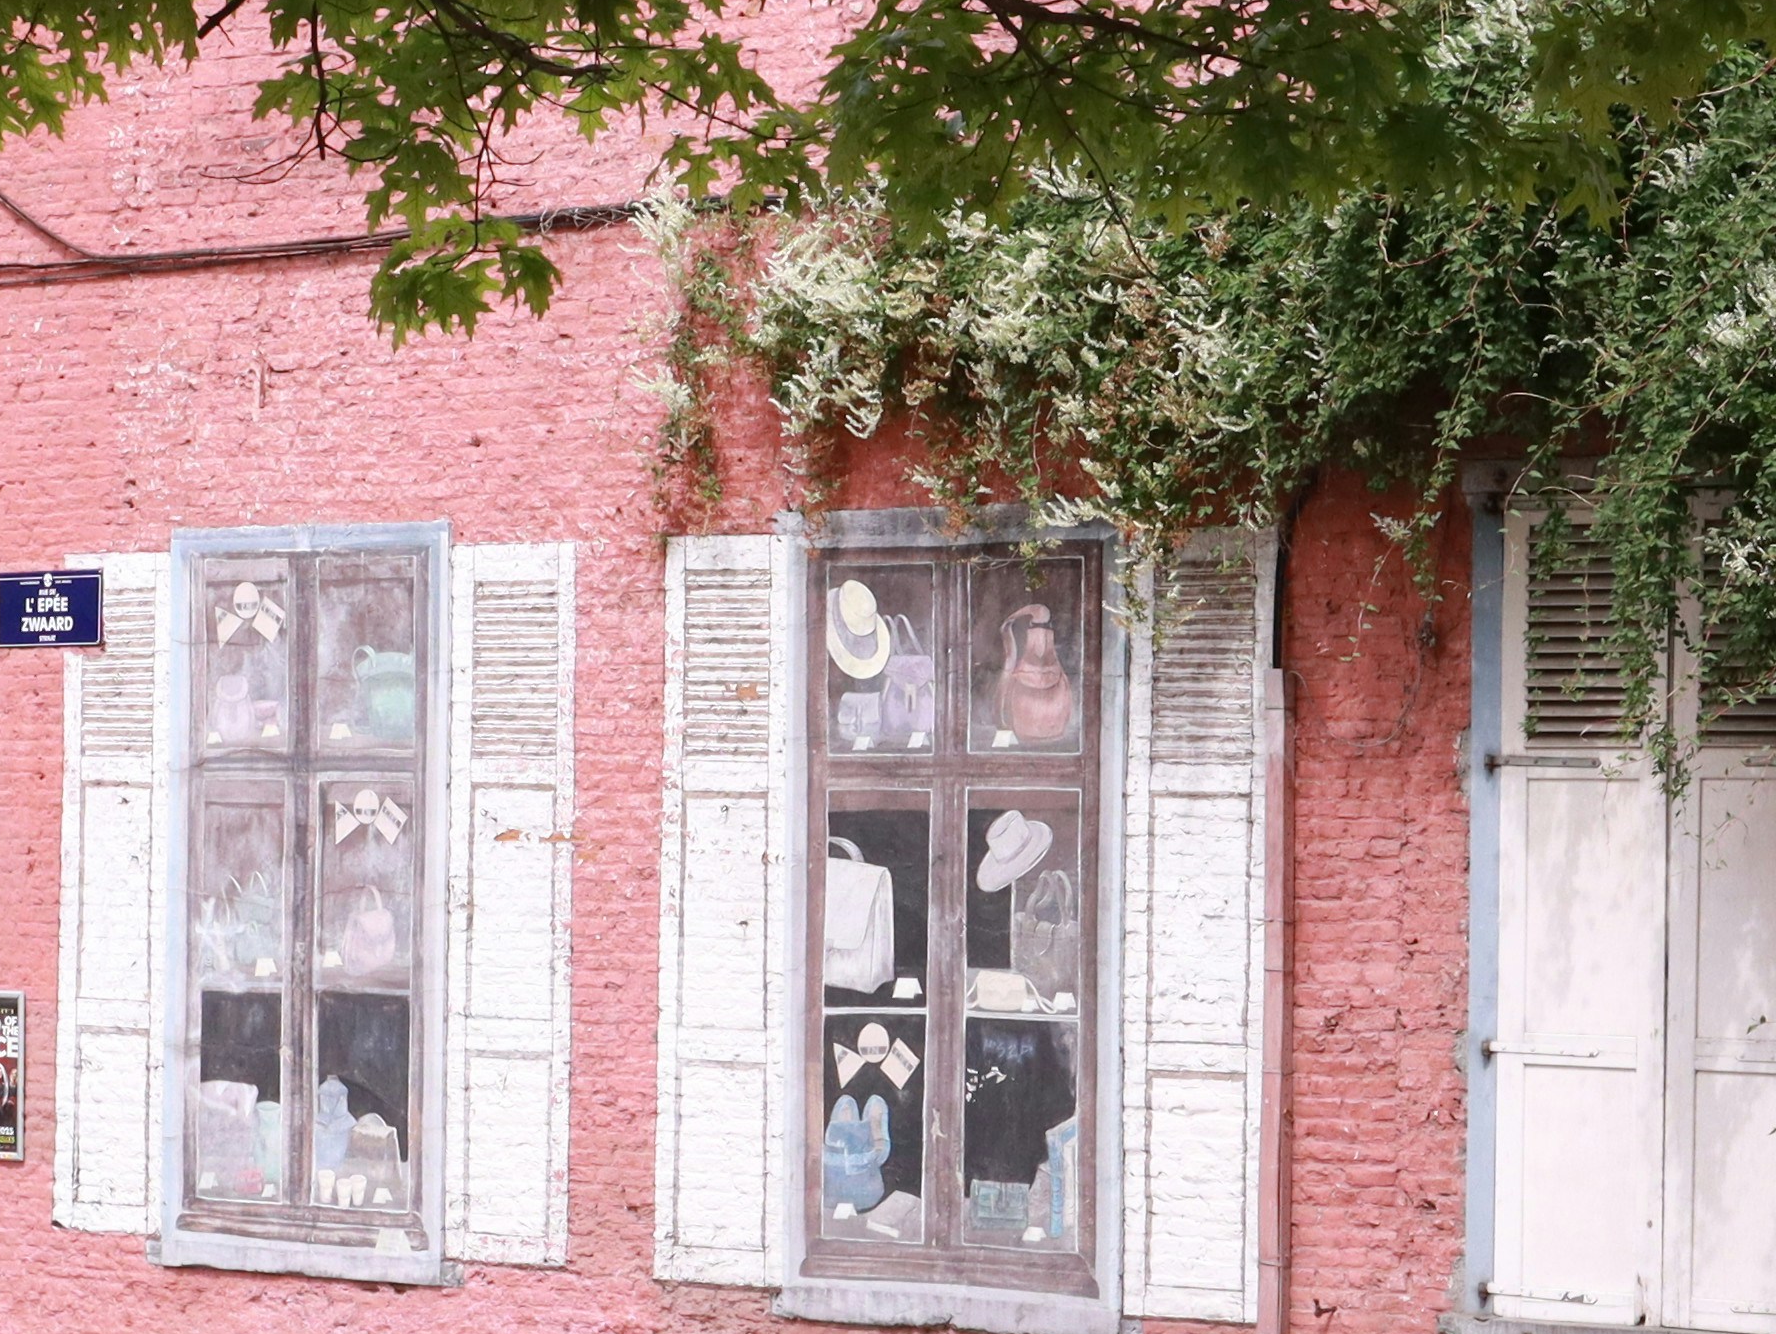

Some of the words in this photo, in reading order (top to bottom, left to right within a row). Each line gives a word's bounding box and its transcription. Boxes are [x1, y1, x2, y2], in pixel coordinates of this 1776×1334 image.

[25, 597, 34, 613] L'
[37, 593, 69, 613] EPÉE
[21, 616, 74, 632] ZWAARD
[4, 1015, 17, 1026] OF
[2, 1025, 18, 1036] THE
